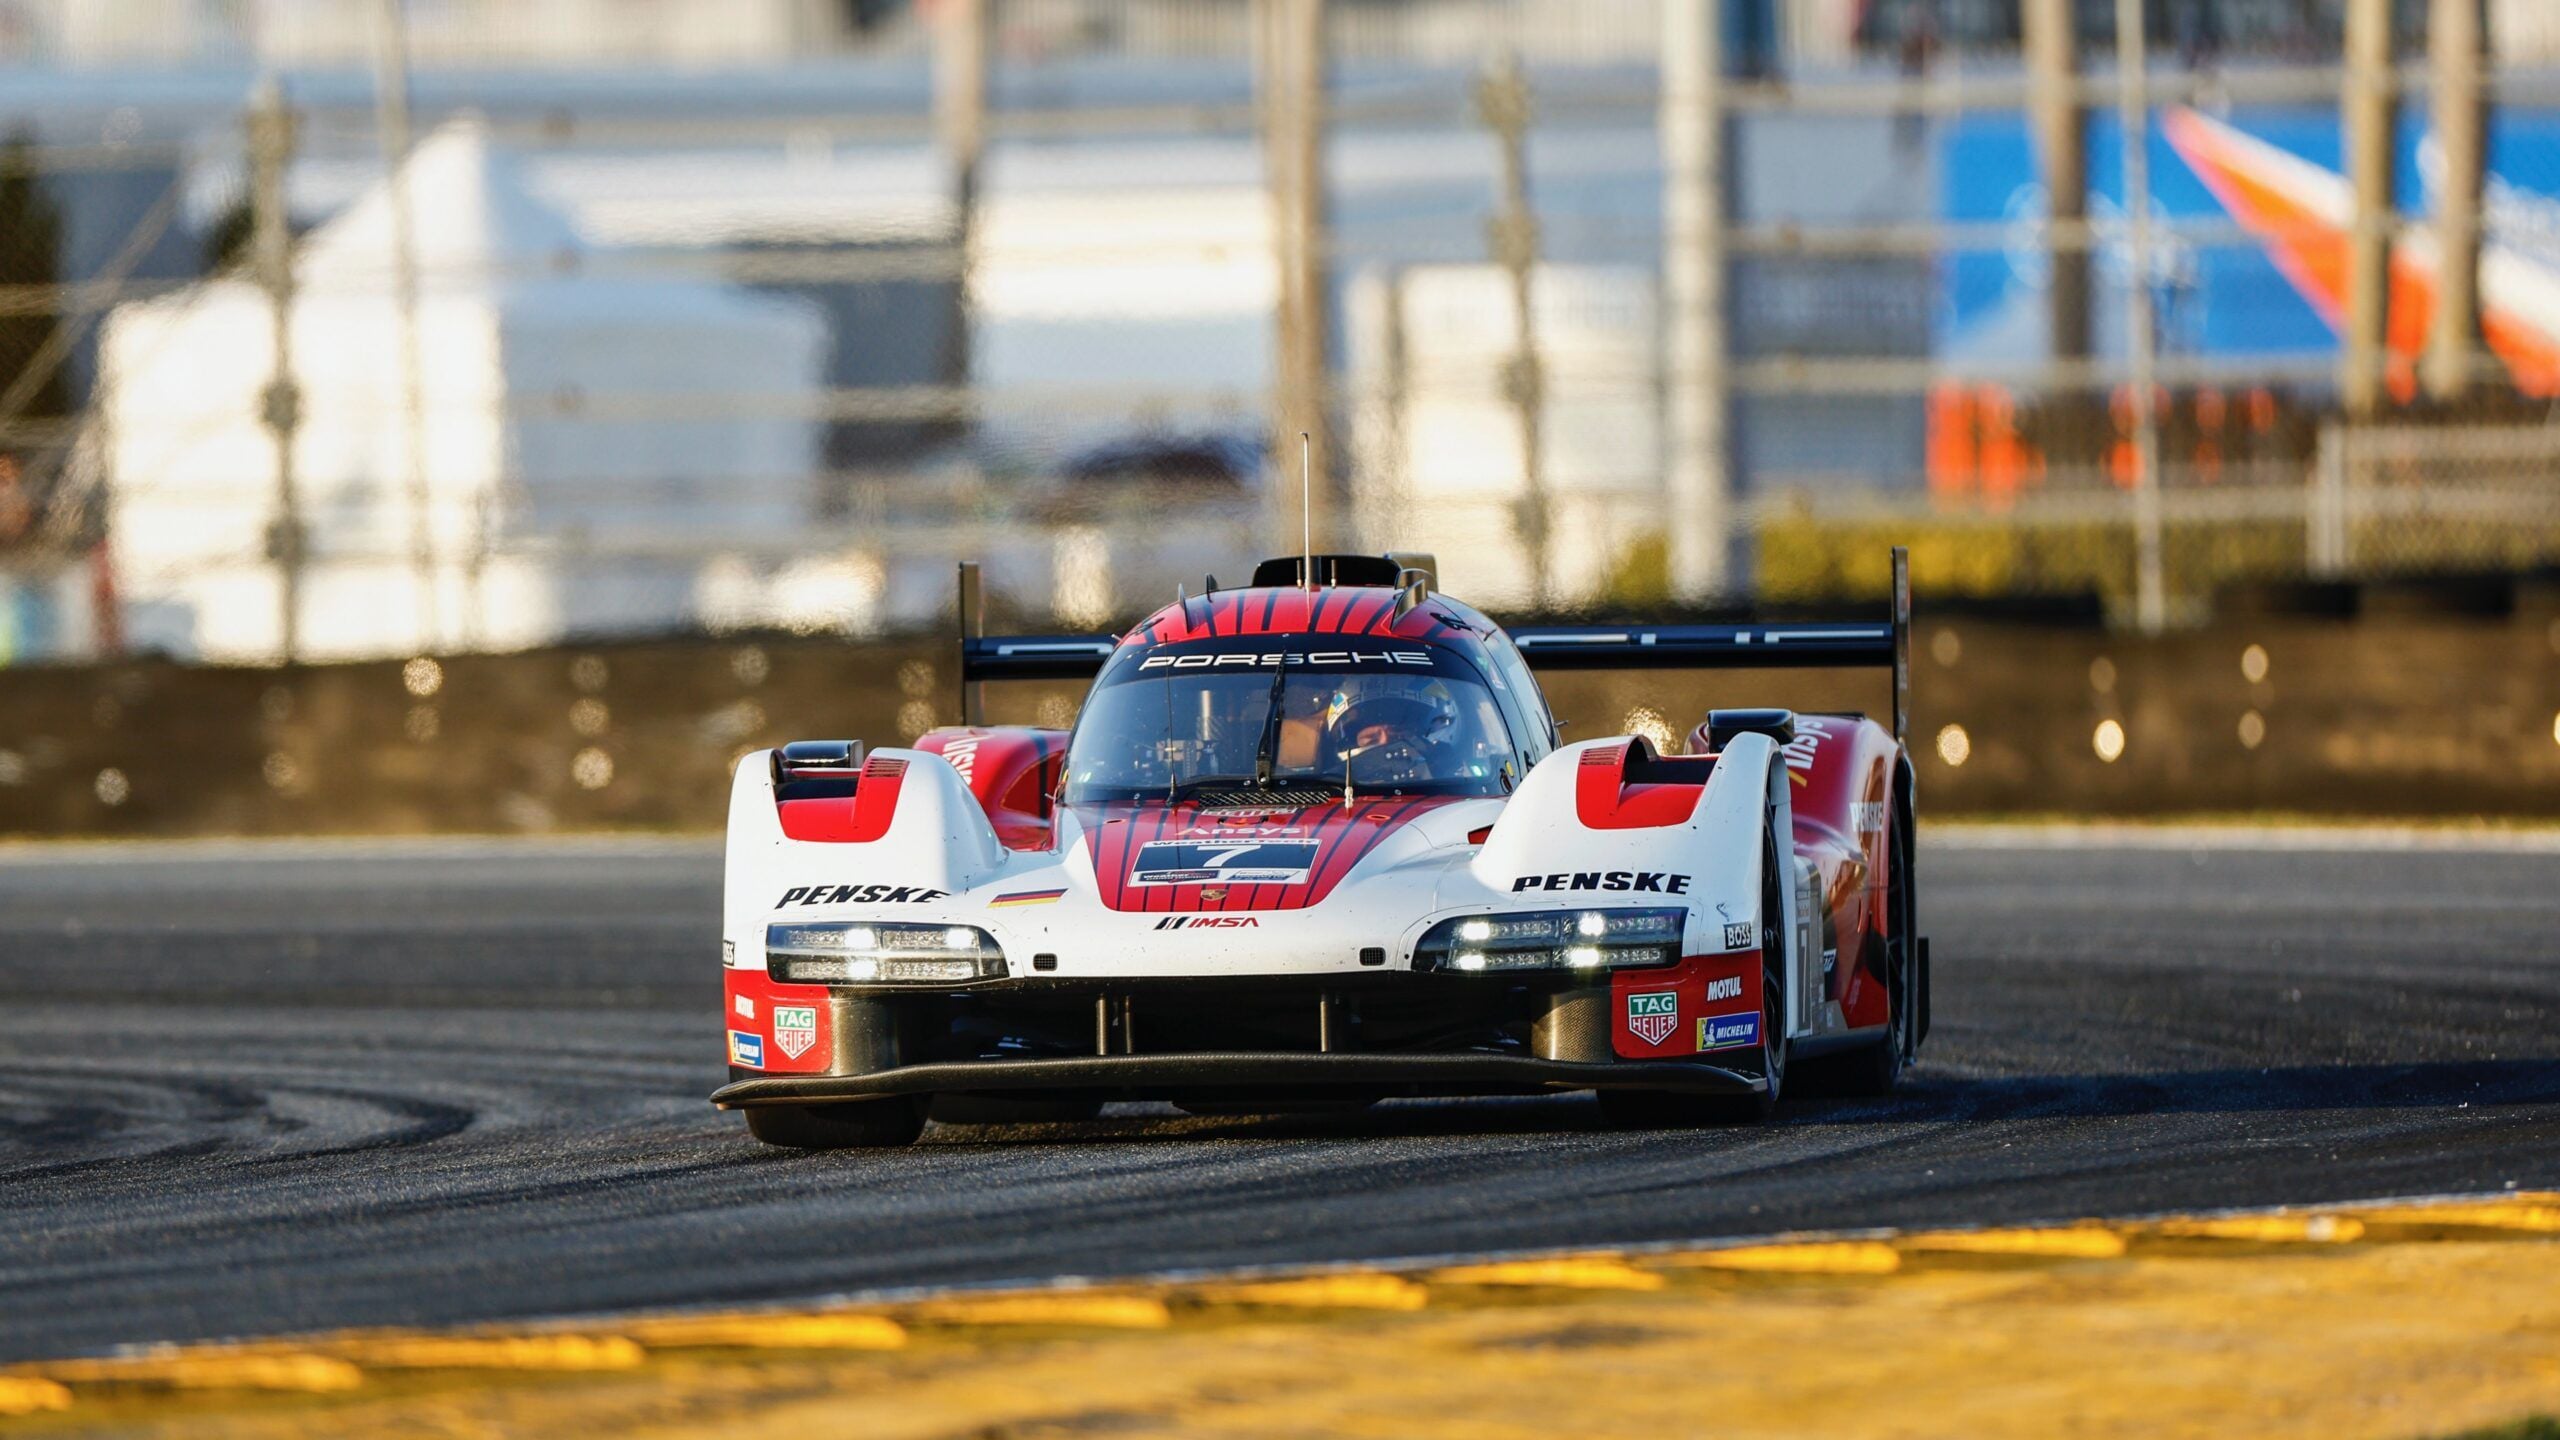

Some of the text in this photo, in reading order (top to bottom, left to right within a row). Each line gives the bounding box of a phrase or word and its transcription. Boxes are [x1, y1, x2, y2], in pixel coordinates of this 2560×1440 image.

[1139, 650, 1434, 671] PORSCHE
[1175, 827, 1302, 836] Ansys
[1196, 845, 1261, 867] 7
[1512, 872, 1691, 894] PENSKE
[774, 885, 952, 909] PENSKE
[1187, 917, 1259, 928] IMSA
[1727, 925, 1751, 946] BOSS
[1707, 976, 1742, 1001] MOTUL
[1632, 997, 1675, 1013] TAG
[777, 1011, 812, 1027] TAG
[1632, 1015, 1677, 1039] HEUER
[1716, 1023, 1754, 1039] MICHELIN
[776, 1030, 814, 1055] HEUER
